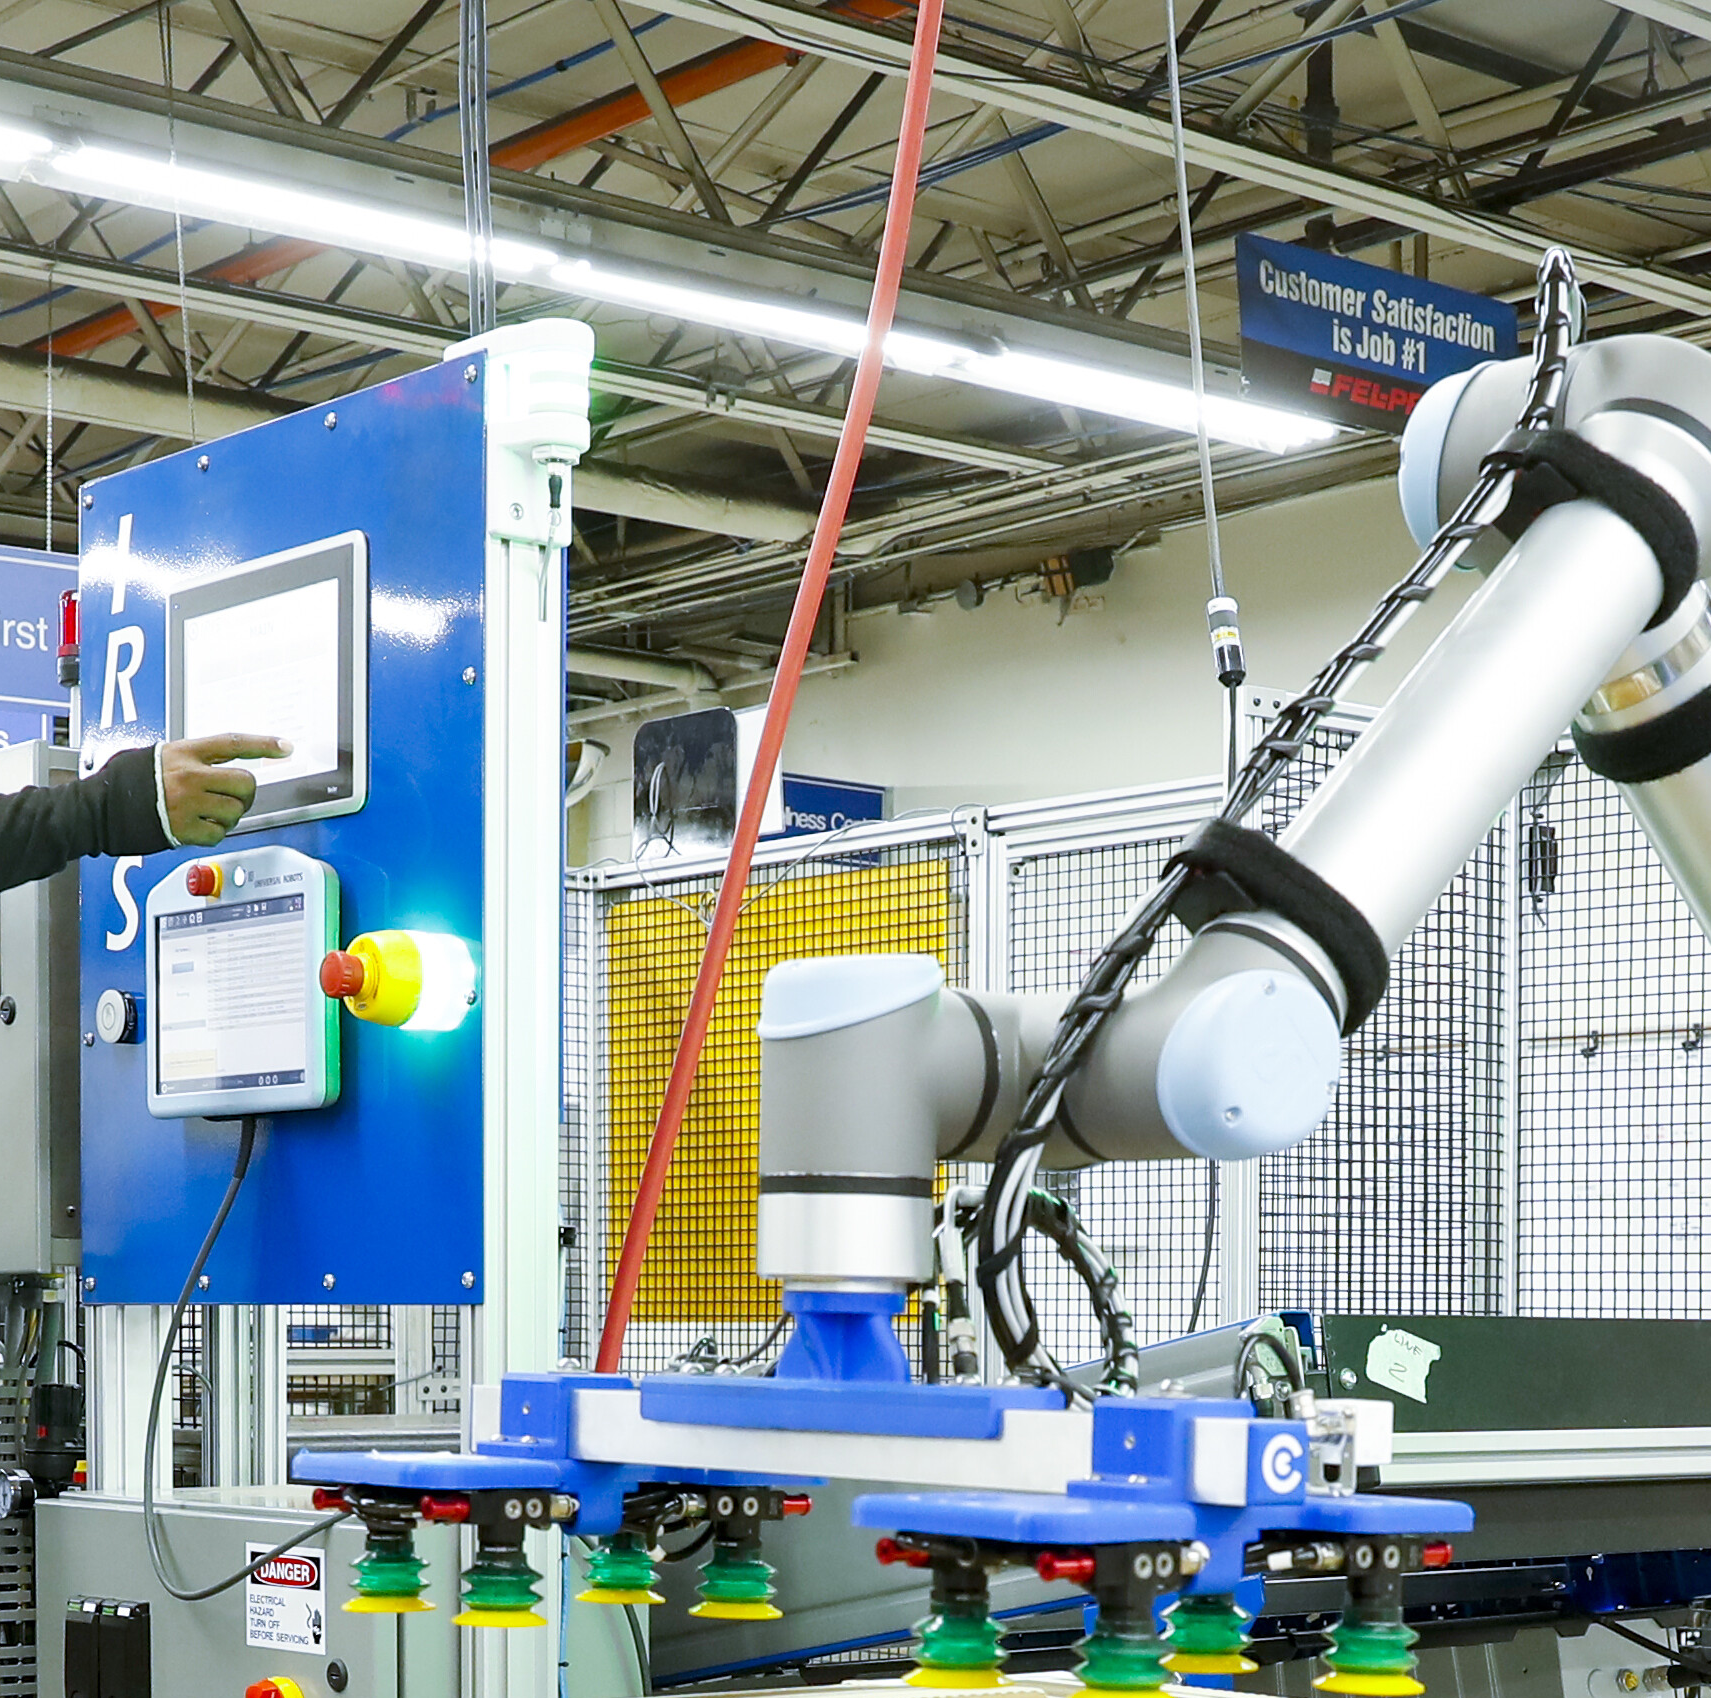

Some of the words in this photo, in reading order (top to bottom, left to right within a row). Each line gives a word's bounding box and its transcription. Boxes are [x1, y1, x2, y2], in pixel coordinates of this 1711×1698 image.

[1258, 258, 1366, 319] Customer
[1372, 289, 1495, 353] Satisfaction
[1332, 319, 1352, 356] is
[1356, 326, 1396, 368] Job
[1402, 337, 1426, 374] #1
[1393, 1333, 1423, 1357] LINE
[260, 1561, 310, 1582] DANGER
[250, 1594, 285, 1607] ELECTRICAL
[250, 1607, 274, 1617] HAZARD
[250, 1618, 266, 1628] TURN
[269, 1620, 280, 1629] OFF
[250, 1629, 274, 1641] BEFORE
[276, 1633, 309, 1645] SERVICING
